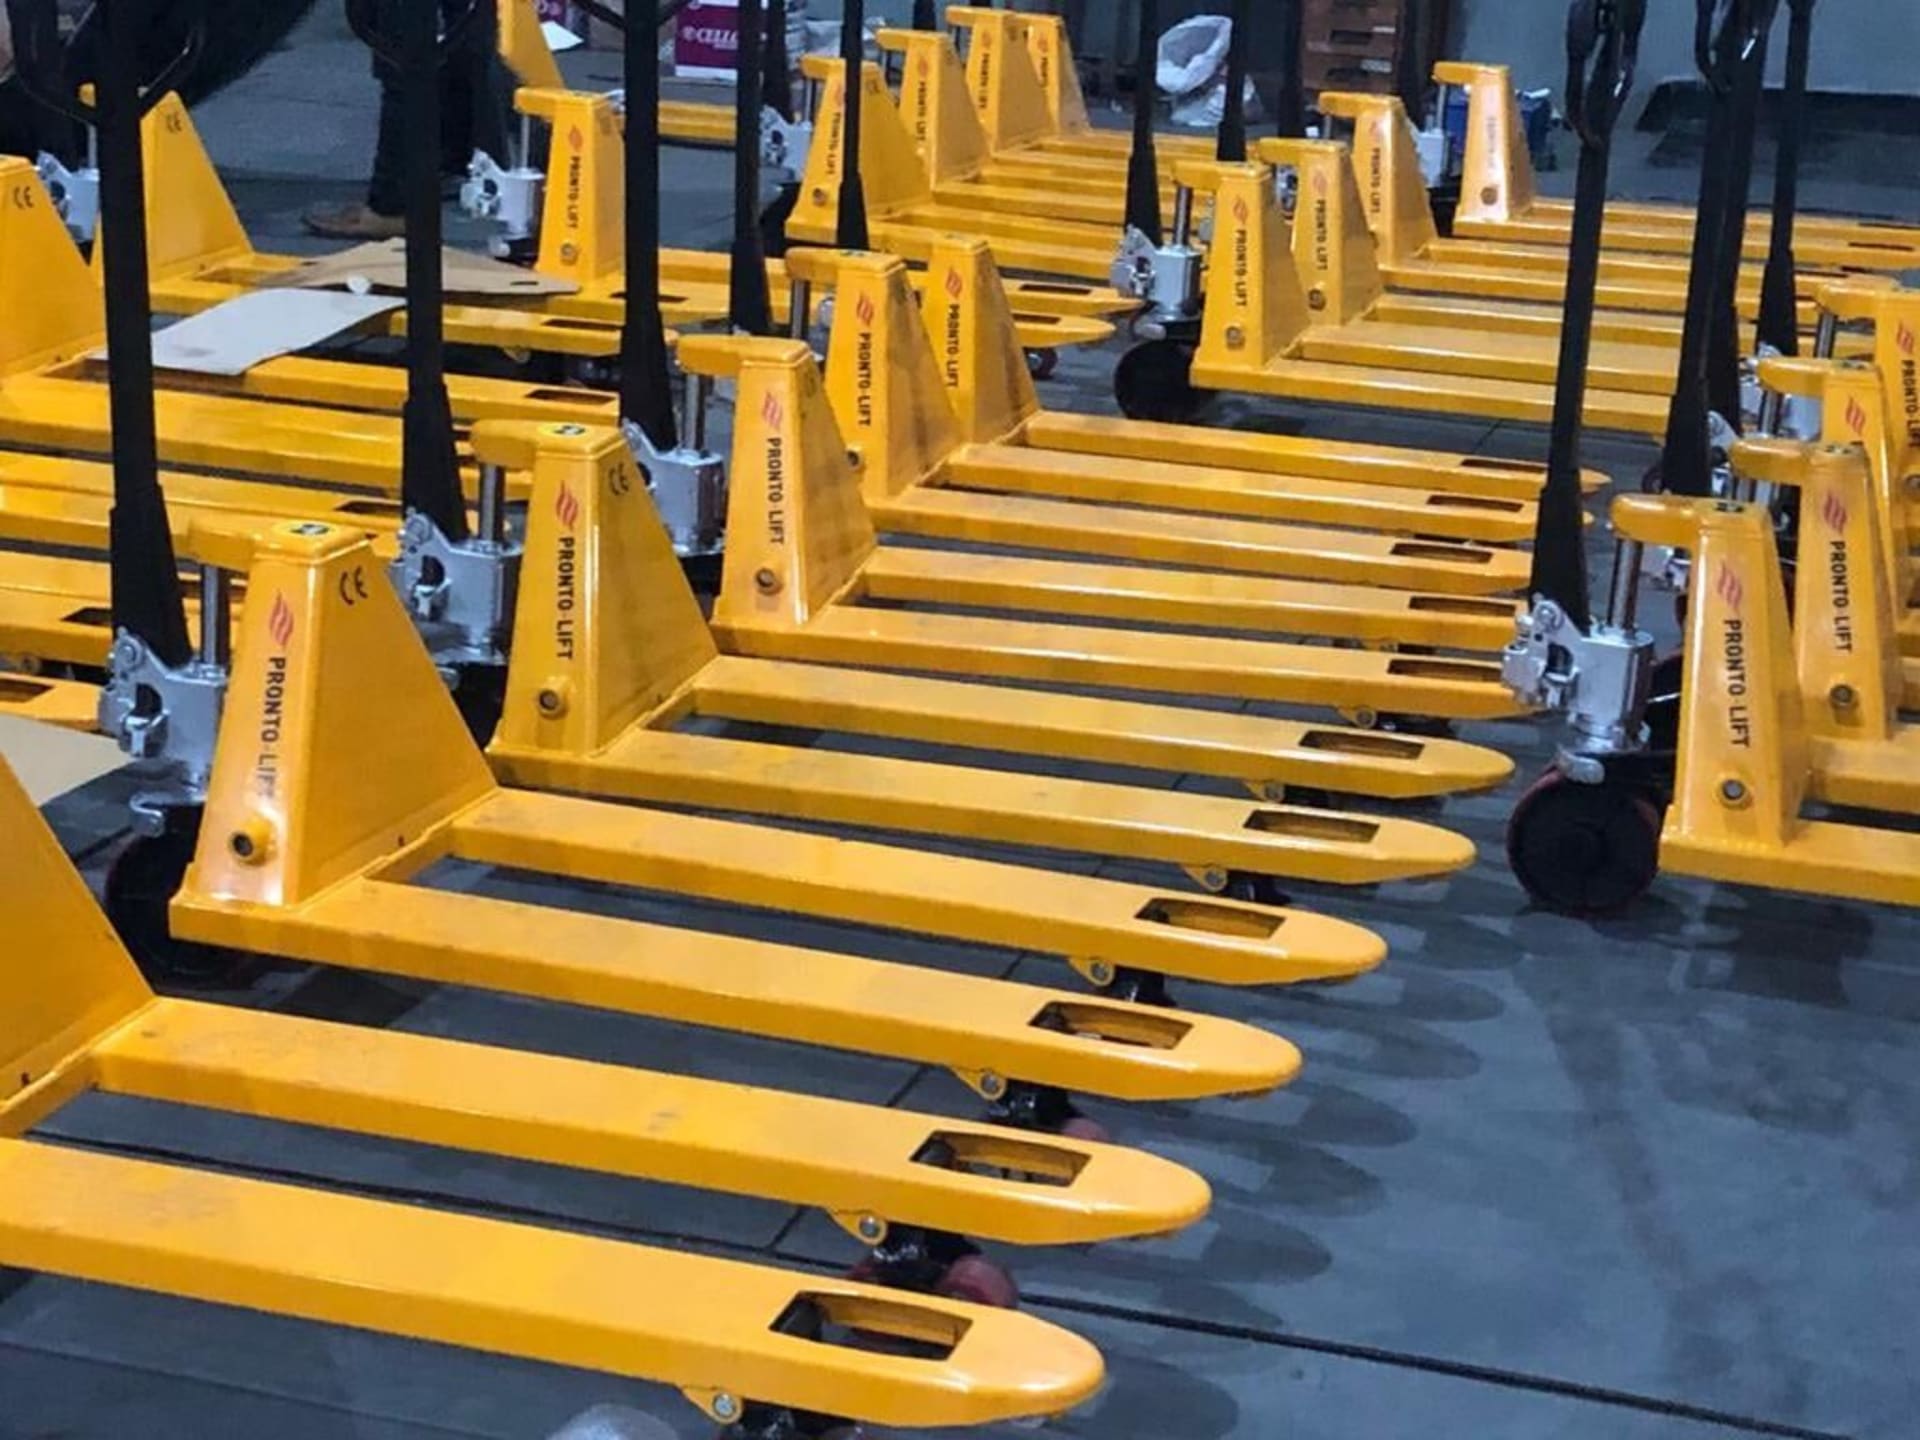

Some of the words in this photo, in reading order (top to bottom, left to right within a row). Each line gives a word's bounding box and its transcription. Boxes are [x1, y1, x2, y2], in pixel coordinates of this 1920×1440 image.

[1315, 199, 1327, 242] PRONTO
[1235, 229, 1247, 276] PRONTO
[1317, 247, 1328, 270] LIFT
[1235, 282, 1247, 307] LIFT
[946, 304, 960, 354] PRONTO
[857, 333, 871, 389] PRONTO
[946, 360, 959, 388] LIFT
[1901, 360, 1919, 414] PRONTO
[857, 395, 871, 427] LIFT
[767, 437, 783, 502] PRONTO
[768, 510, 784, 544] LIFT
[339, 565, 368, 606] CE
[557, 537, 575, 611] PRONTO
[1830, 541, 1849, 608] PRONTO
[556, 620, 574, 660] LIFT
[1834, 616, 1852, 652] LIFT
[1723, 619, 1747, 696] PRONTO
[261, 657, 286, 743] PRONTO
[1729, 706, 1750, 748] LIFT
[256, 753, 279, 799] LIFT
